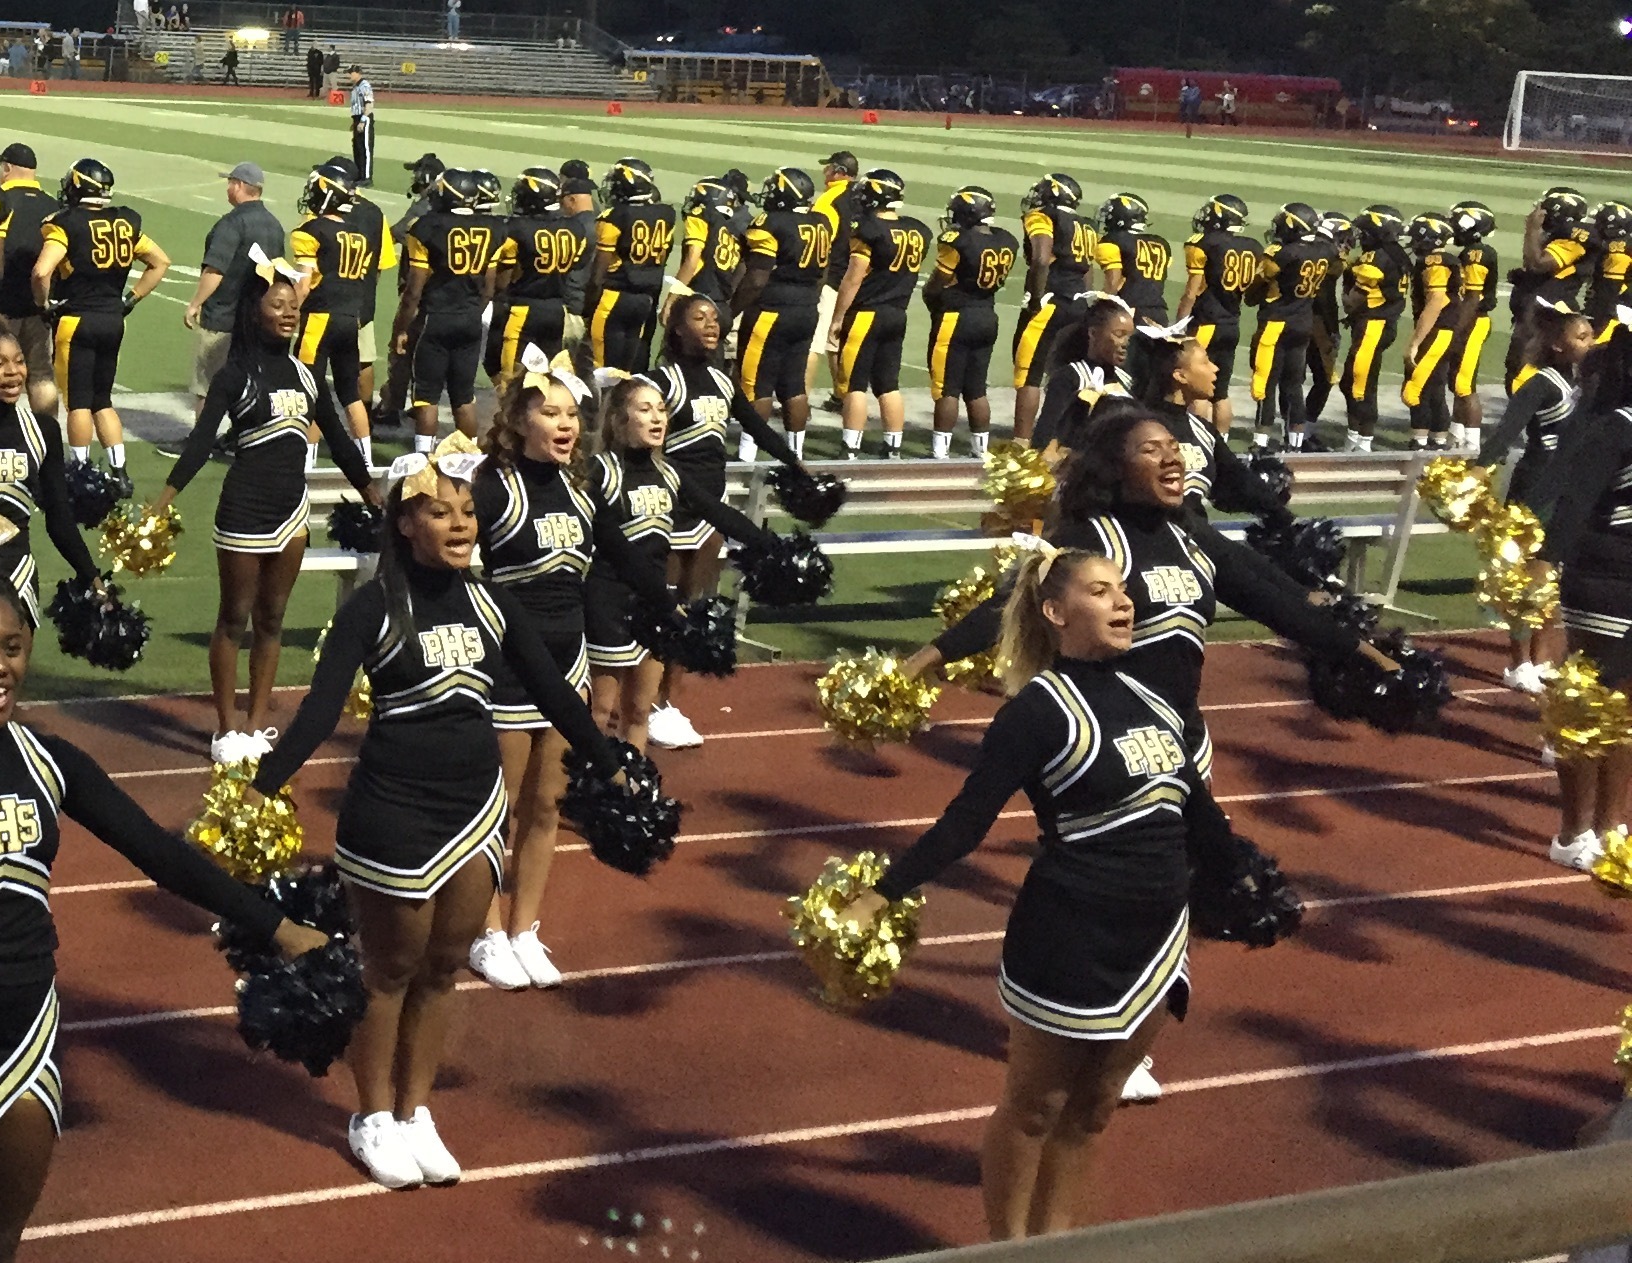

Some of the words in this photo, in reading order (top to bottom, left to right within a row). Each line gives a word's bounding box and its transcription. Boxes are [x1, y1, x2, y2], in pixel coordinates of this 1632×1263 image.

[156, 52, 167, 61] 20
[89, 218, 134, 269] 56
[336, 231, 367, 279] 17
[448, 228, 491, 275] 67
[534, 229, 576, 274] 90
[629, 219, 667, 264] 84
[798, 223, 830, 268] 70
[889, 228, 924, 273] 73
[1135, 239, 1167, 281] 47
[1221, 249, 1256, 291] 80
[269, 390, 309, 418] PHS
[691, 396, 729, 421] PHS
[628, 485, 672, 516] PHS
[534, 513, 584, 549] PHS
[1141, 566, 1203, 606] PHS
[418, 623, 485, 669] PHS
[1114, 725, 1185, 778] PHS
